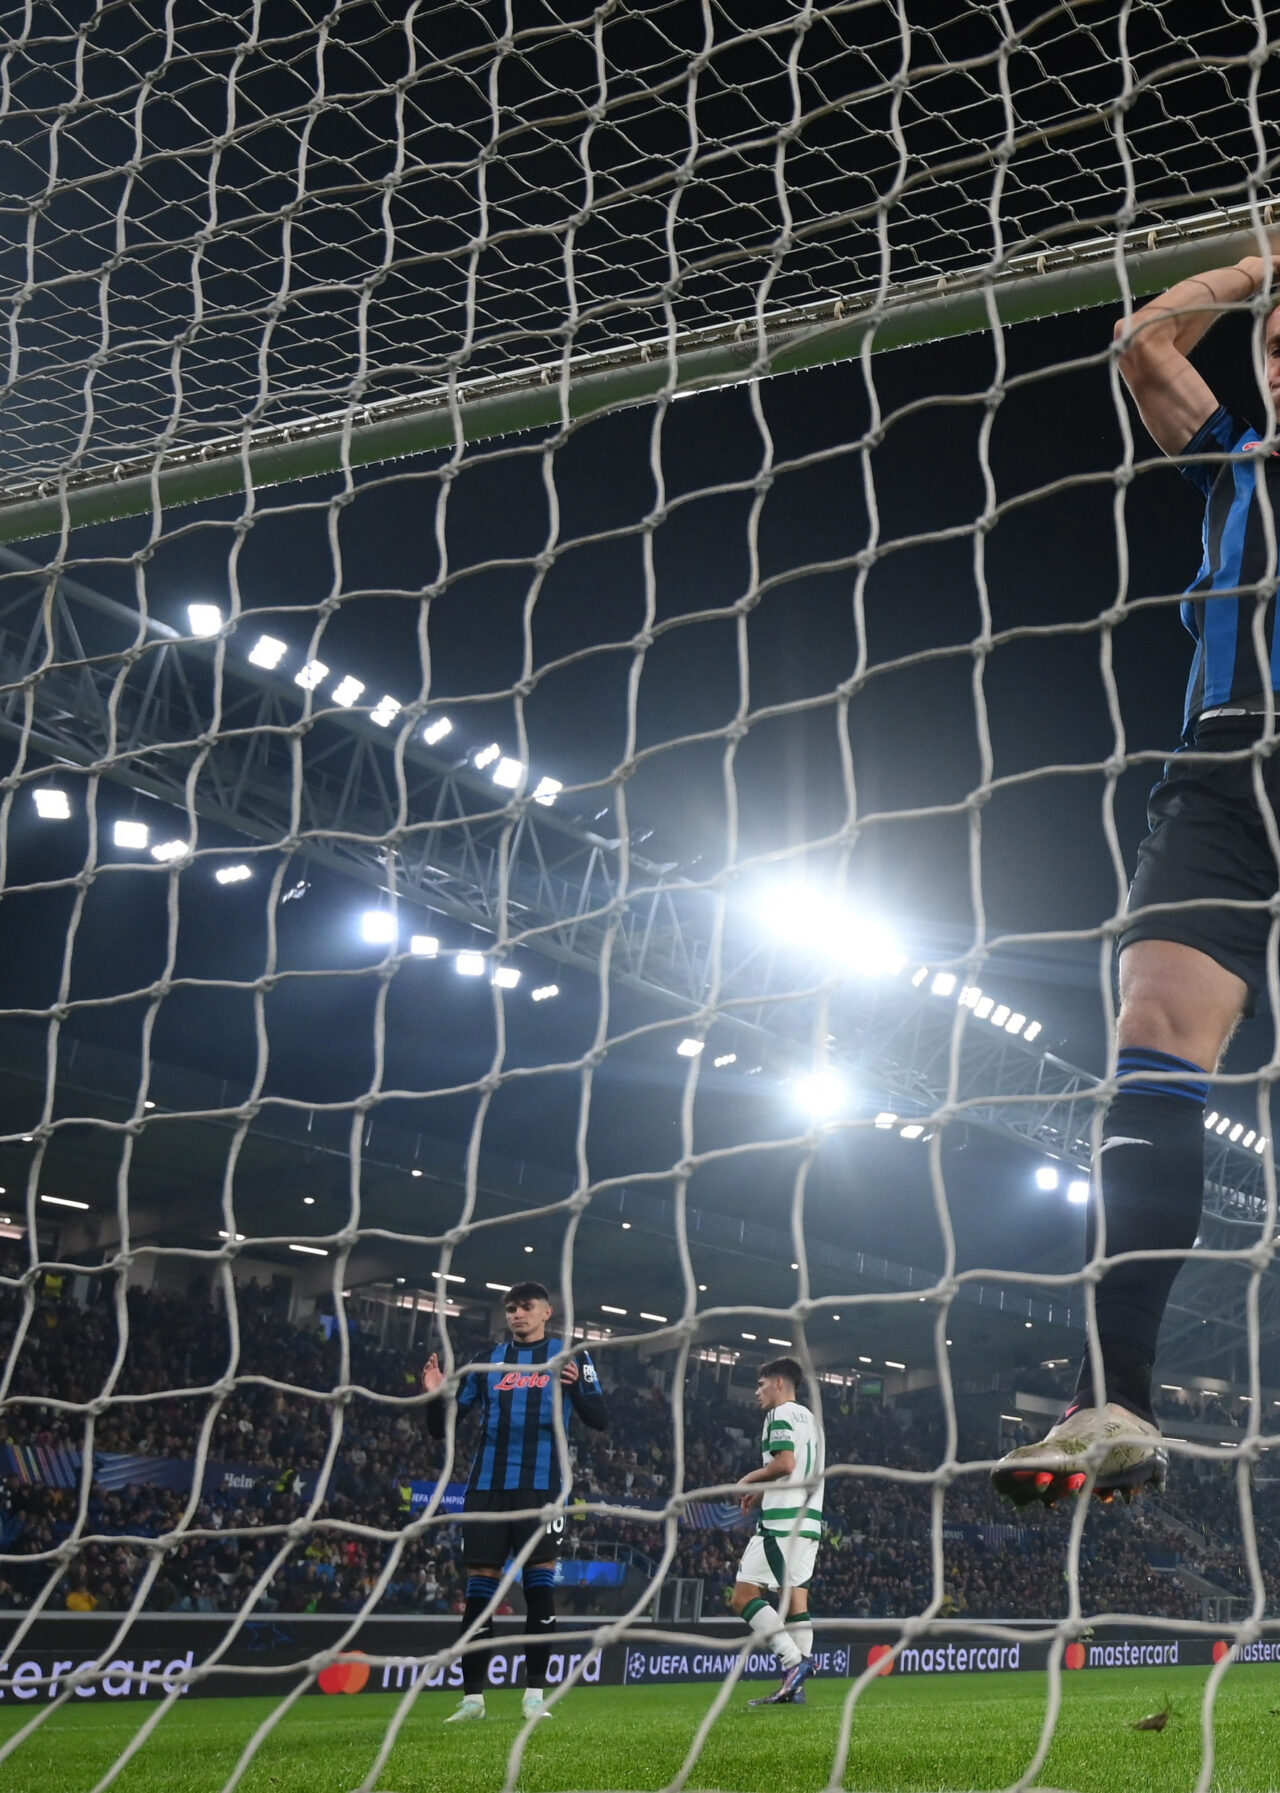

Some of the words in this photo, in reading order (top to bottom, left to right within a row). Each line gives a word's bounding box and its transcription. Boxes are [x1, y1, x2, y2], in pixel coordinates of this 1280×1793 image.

[382, 1648, 602, 1688] maserard
[649, 1655, 689, 1676] UEFA
[900, 1643, 1020, 1673] mastercard
[1090, 1641, 1179, 1667] mastercard
